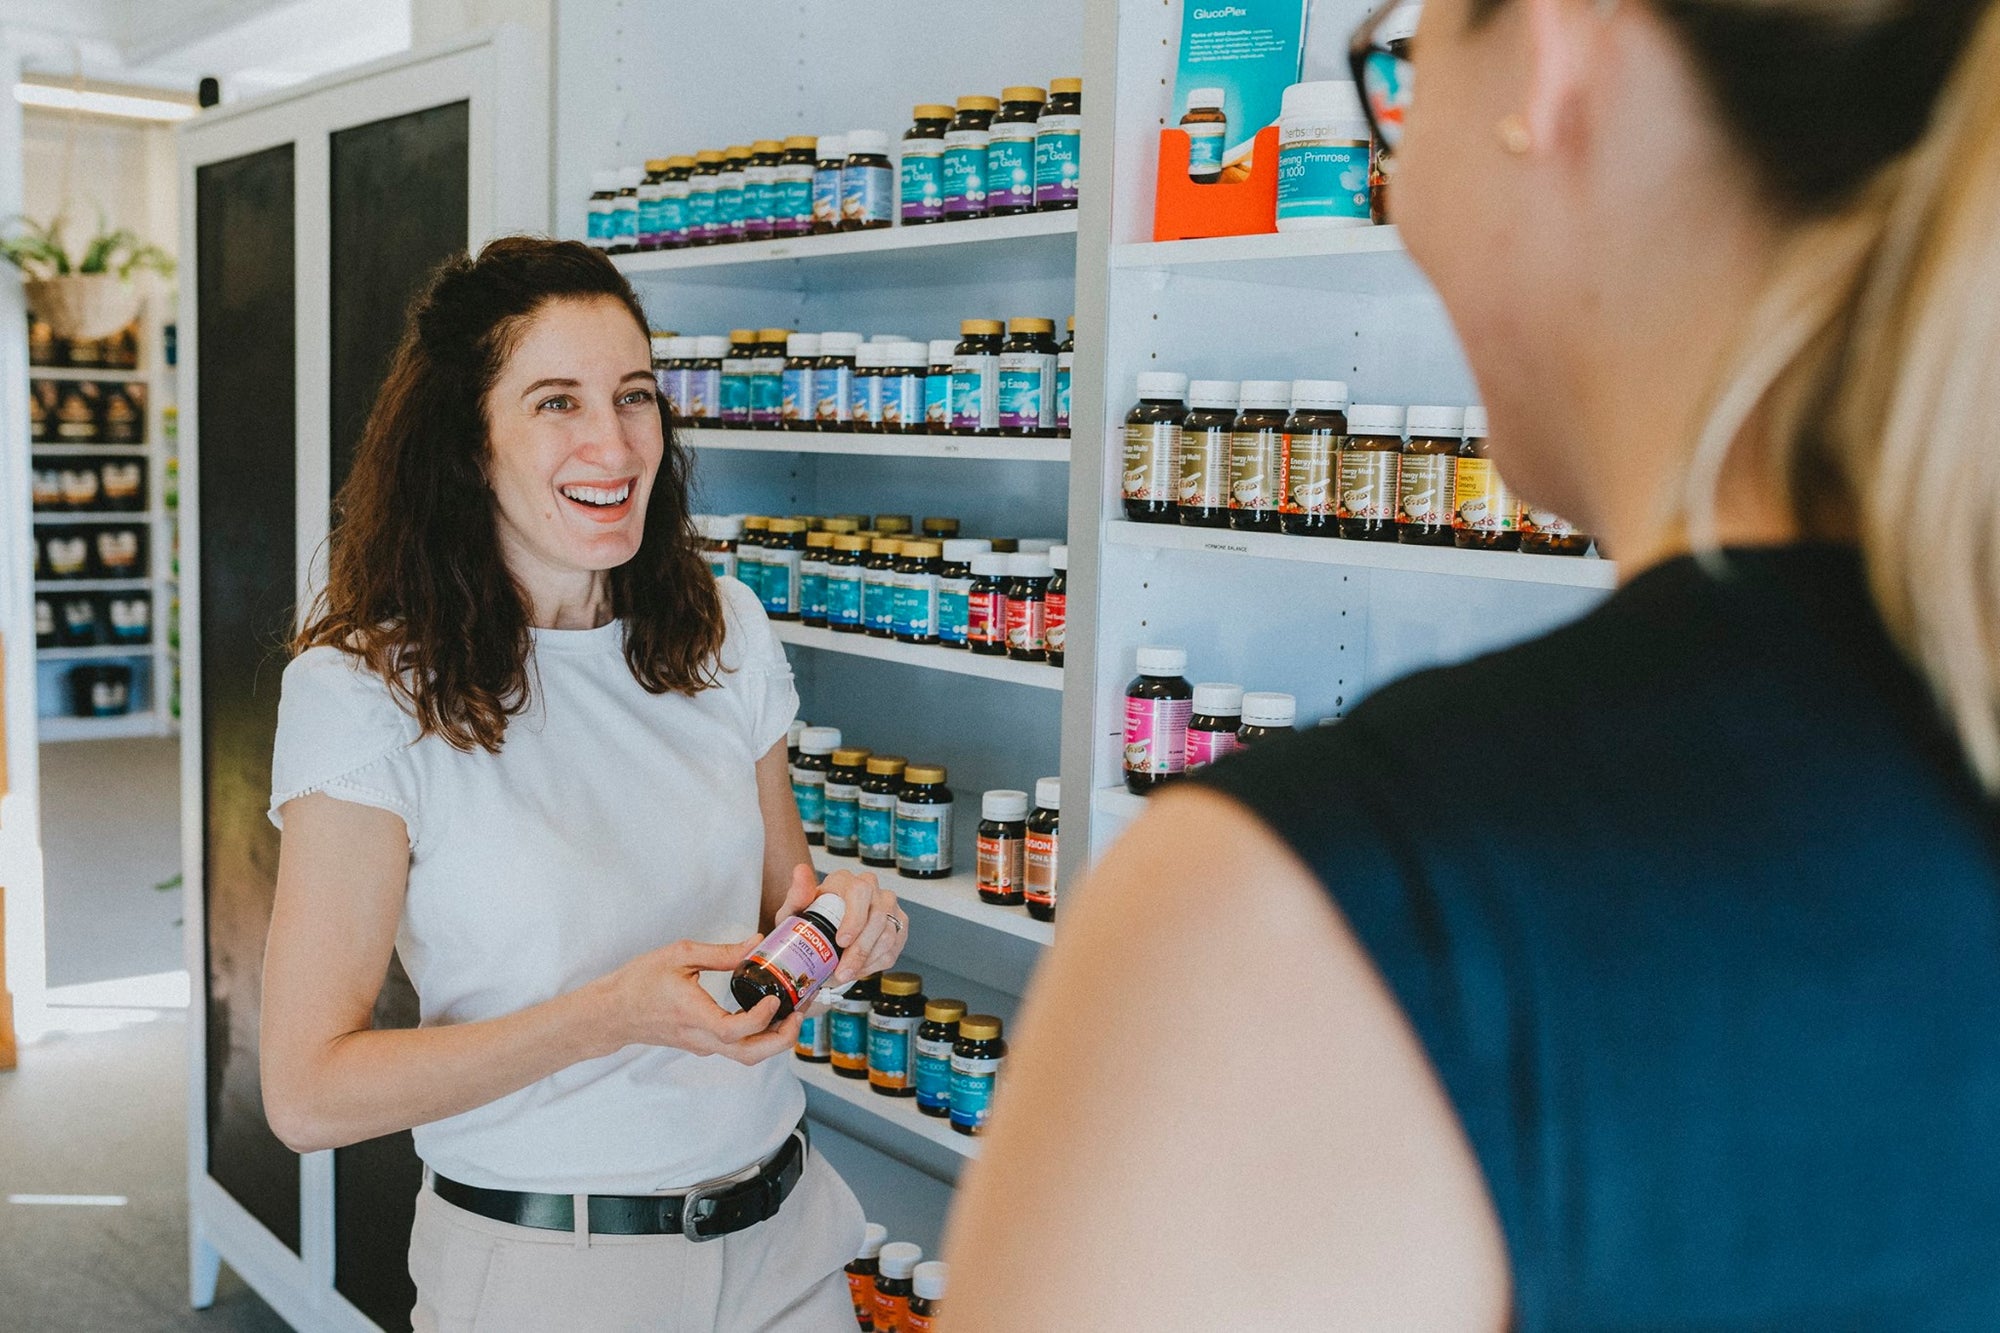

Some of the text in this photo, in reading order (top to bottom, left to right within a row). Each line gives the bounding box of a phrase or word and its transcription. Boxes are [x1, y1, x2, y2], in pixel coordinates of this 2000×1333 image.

[1193, 6, 1247, 19] GlucoPlex
[1056, 140, 1062, 149] 4
[1006, 148, 1012, 156] 4
[1050, 151, 1072, 161] Gold
[1305, 152, 1350, 163] Primrose
[1000, 157, 1021, 167] Gold
[954, 164, 976, 174] Gold
[1287, 165, 1305, 177] 1000
[1279, 457, 1287, 506] FUSION
[795, 924, 825, 954] FUSION
[798, 940, 815, 957] VITEX
